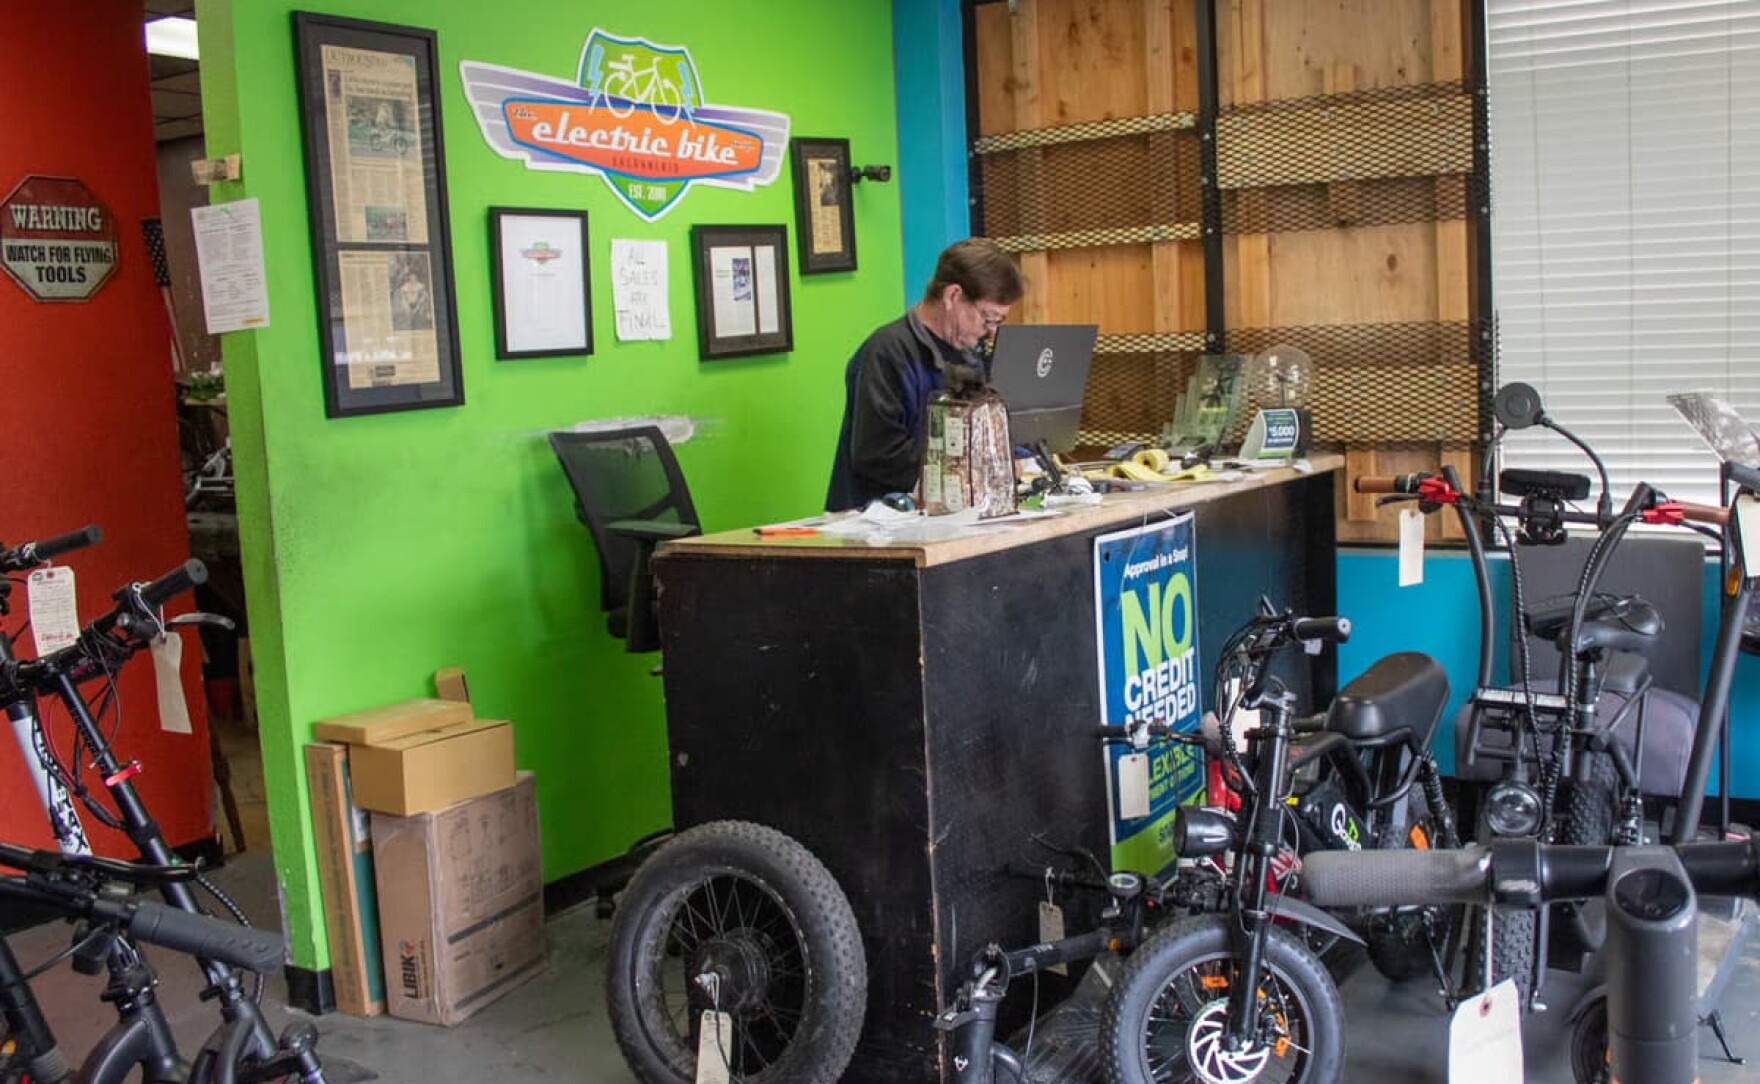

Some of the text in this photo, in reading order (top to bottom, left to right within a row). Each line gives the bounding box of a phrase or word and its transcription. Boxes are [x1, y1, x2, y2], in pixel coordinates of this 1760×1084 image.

[532, 111, 738, 165] electric bike
[10, 204, 102, 231] WARNING
[6, 244, 112, 264] WATCH FOR FLYING
[35, 265, 87, 283] TOOLS
[614, 308, 667, 334] FINAL
[1124, 553, 1160, 579] Approval
[1120, 571, 1193, 675] NO
[1124, 645, 1195, 712] CREDIT
